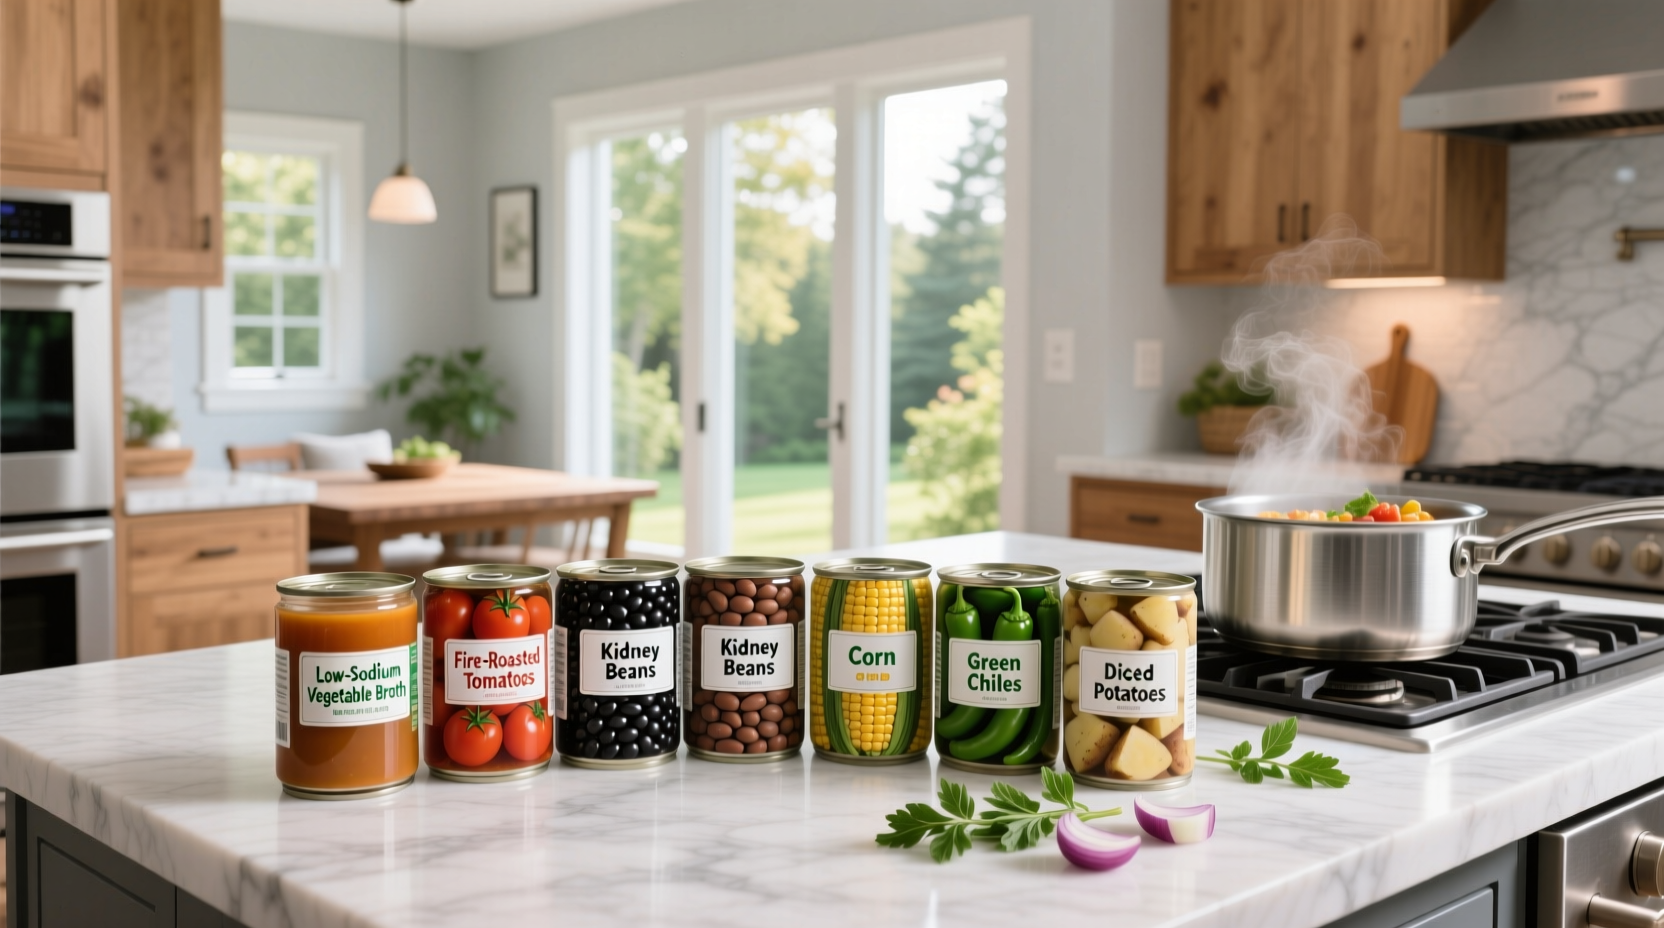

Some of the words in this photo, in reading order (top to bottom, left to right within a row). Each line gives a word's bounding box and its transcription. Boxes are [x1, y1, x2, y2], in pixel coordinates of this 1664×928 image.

[454, 646, 540, 669] Fire-Roasted
[601, 641, 660, 662] Kidney
[721, 638, 779, 659] Kidney
[848, 645, 896, 666] Corn
[606, 663, 656, 680] Beans
[724, 659, 775, 676] Beans
[967, 652, 1021, 671] Green
[1104, 662, 1154, 681] Diced
[316, 662, 401, 683] Low-Sodium
[463, 671, 535, 689] Tomatoes
[967, 673, 1022, 692] Chiles
[307, 685, 372, 707] Vegetable
[376, 681, 406, 700] Broth
[1094, 682, 1166, 702] Potatoes
